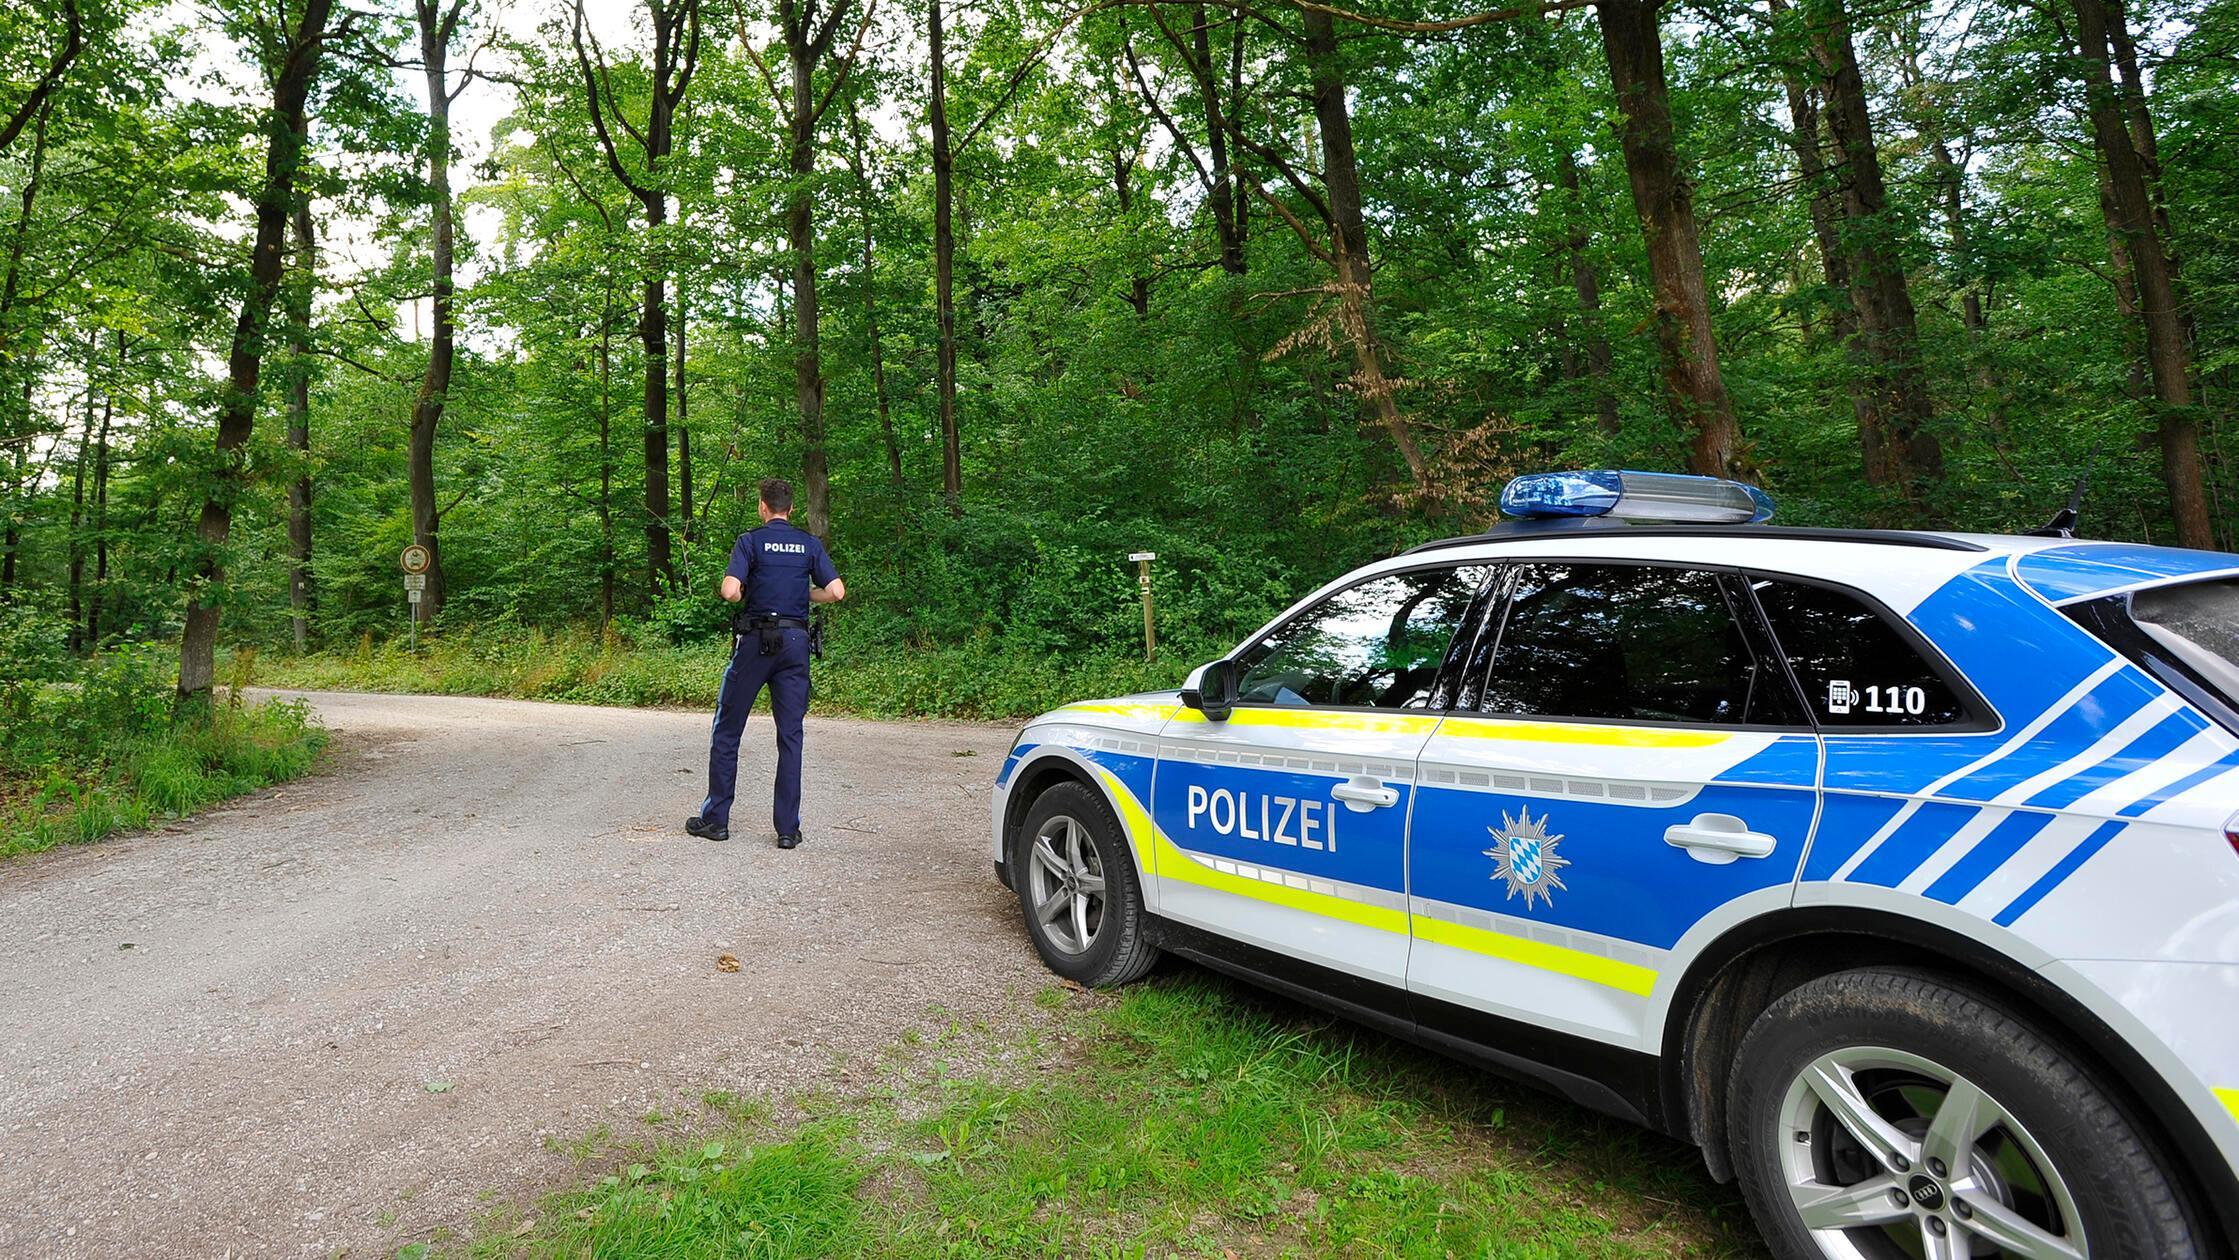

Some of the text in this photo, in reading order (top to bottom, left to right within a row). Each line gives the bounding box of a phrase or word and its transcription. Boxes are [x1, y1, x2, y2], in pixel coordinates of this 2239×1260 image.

[764, 542, 805, 554] POLIZEI
[1865, 685, 1926, 715] 110
[1188, 784, 1337, 853] POLIZEI
